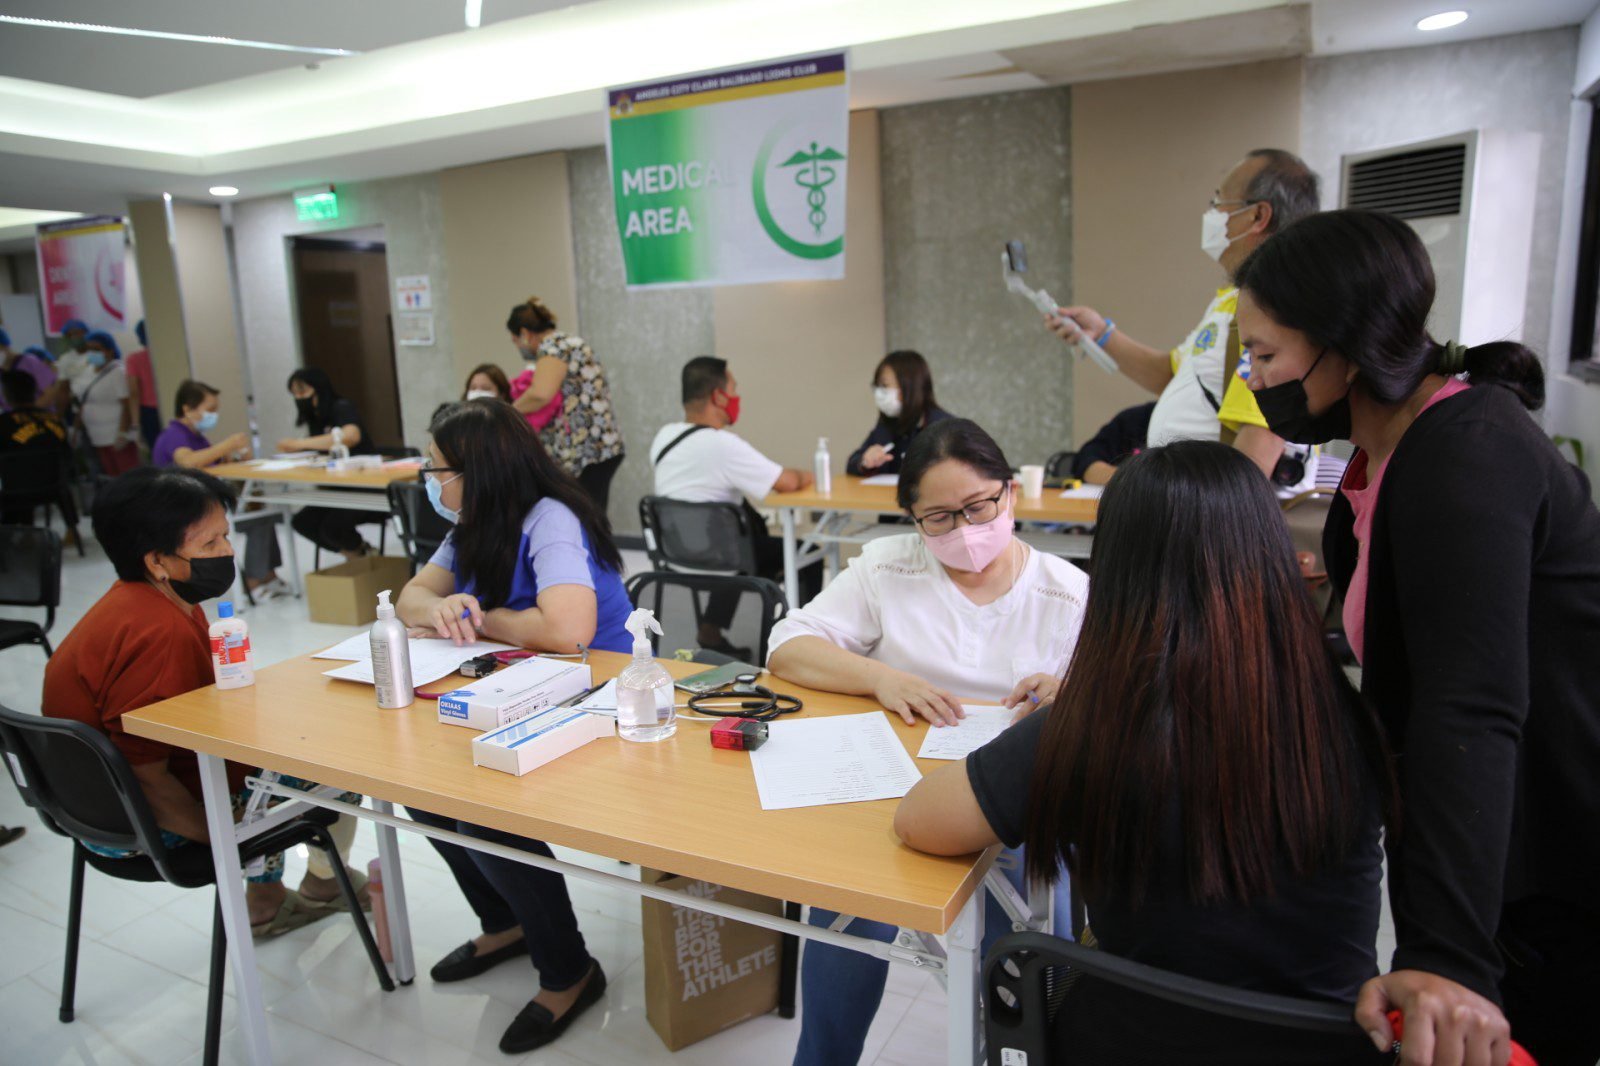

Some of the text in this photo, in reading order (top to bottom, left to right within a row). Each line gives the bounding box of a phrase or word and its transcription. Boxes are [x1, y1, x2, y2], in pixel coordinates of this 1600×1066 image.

[671, 83, 690, 96] CITY
[691, 79, 718, 93] CLARK
[764, 69, 792, 81] LIONS
[793, 63, 817, 76] CLUB
[625, 206, 693, 238] AREA
[676, 931, 721, 965] FOR
[678, 948, 723, 981] THE
[682, 944, 777, 1002] ATHLETE
